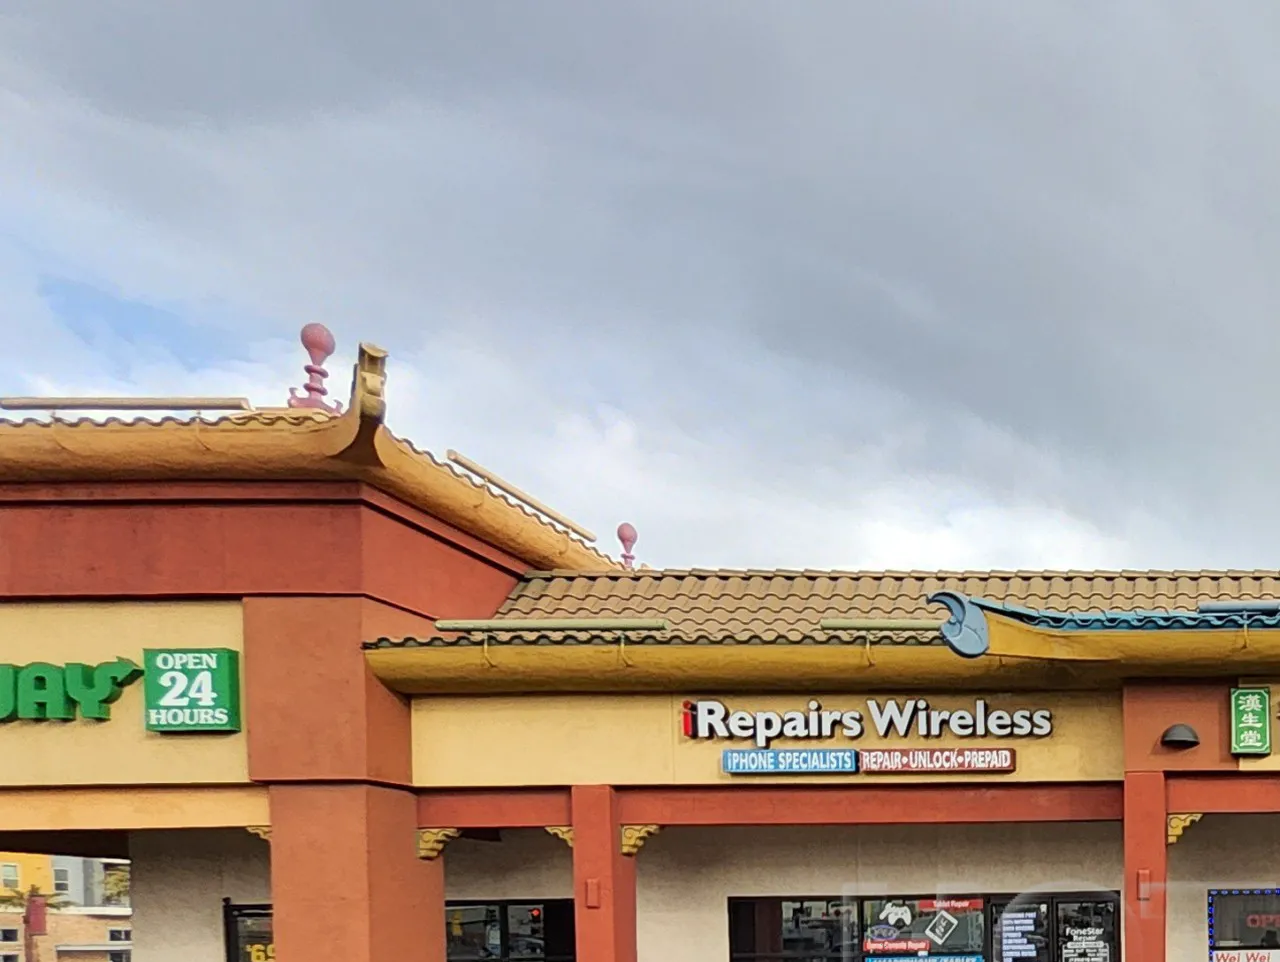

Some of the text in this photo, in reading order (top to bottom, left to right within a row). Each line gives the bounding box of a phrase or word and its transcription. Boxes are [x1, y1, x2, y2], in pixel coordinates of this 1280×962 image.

[156, 653, 218, 669] OPEN
[157, 671, 218, 706] 24
[148, 708, 229, 725] HOURS
[681, 700, 1052, 748] iRepairs Wireless
[727, 750, 852, 768] iPHONE SPECIALISTS
[1246, 951, 1271, 962] Wei
